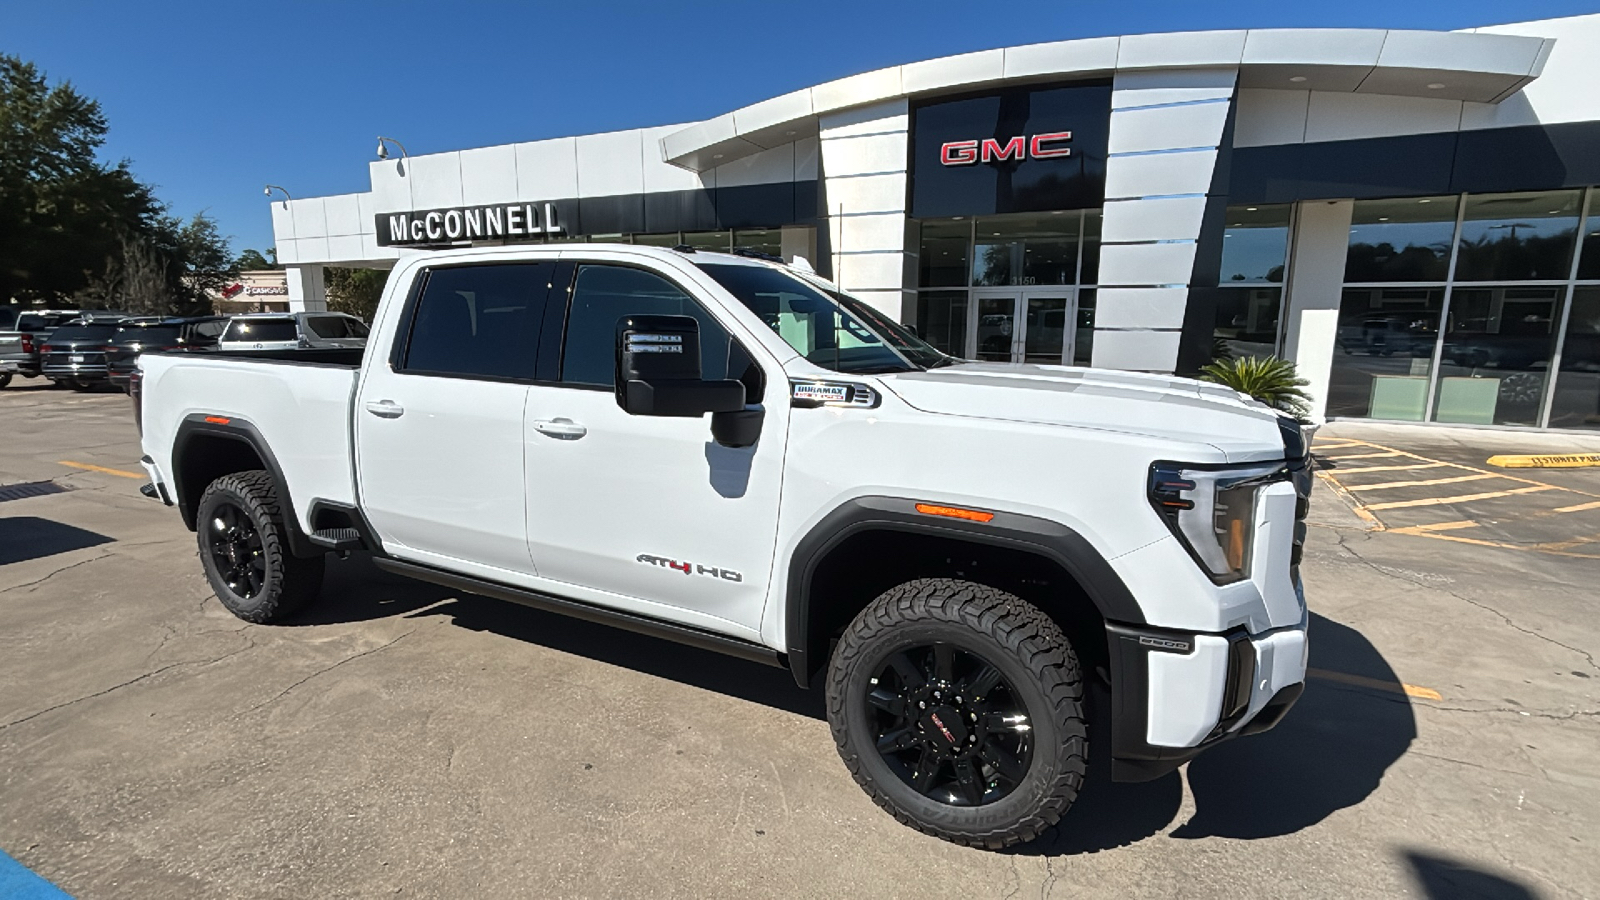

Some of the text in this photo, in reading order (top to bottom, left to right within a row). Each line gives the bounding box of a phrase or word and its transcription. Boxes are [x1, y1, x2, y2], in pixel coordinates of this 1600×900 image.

[940, 131, 1072, 166] GMC
[389, 203, 561, 241] McCONNELL
[797, 386, 844, 395] DURAMAX
[1531, 456, 1578, 464] CUSTOMER
